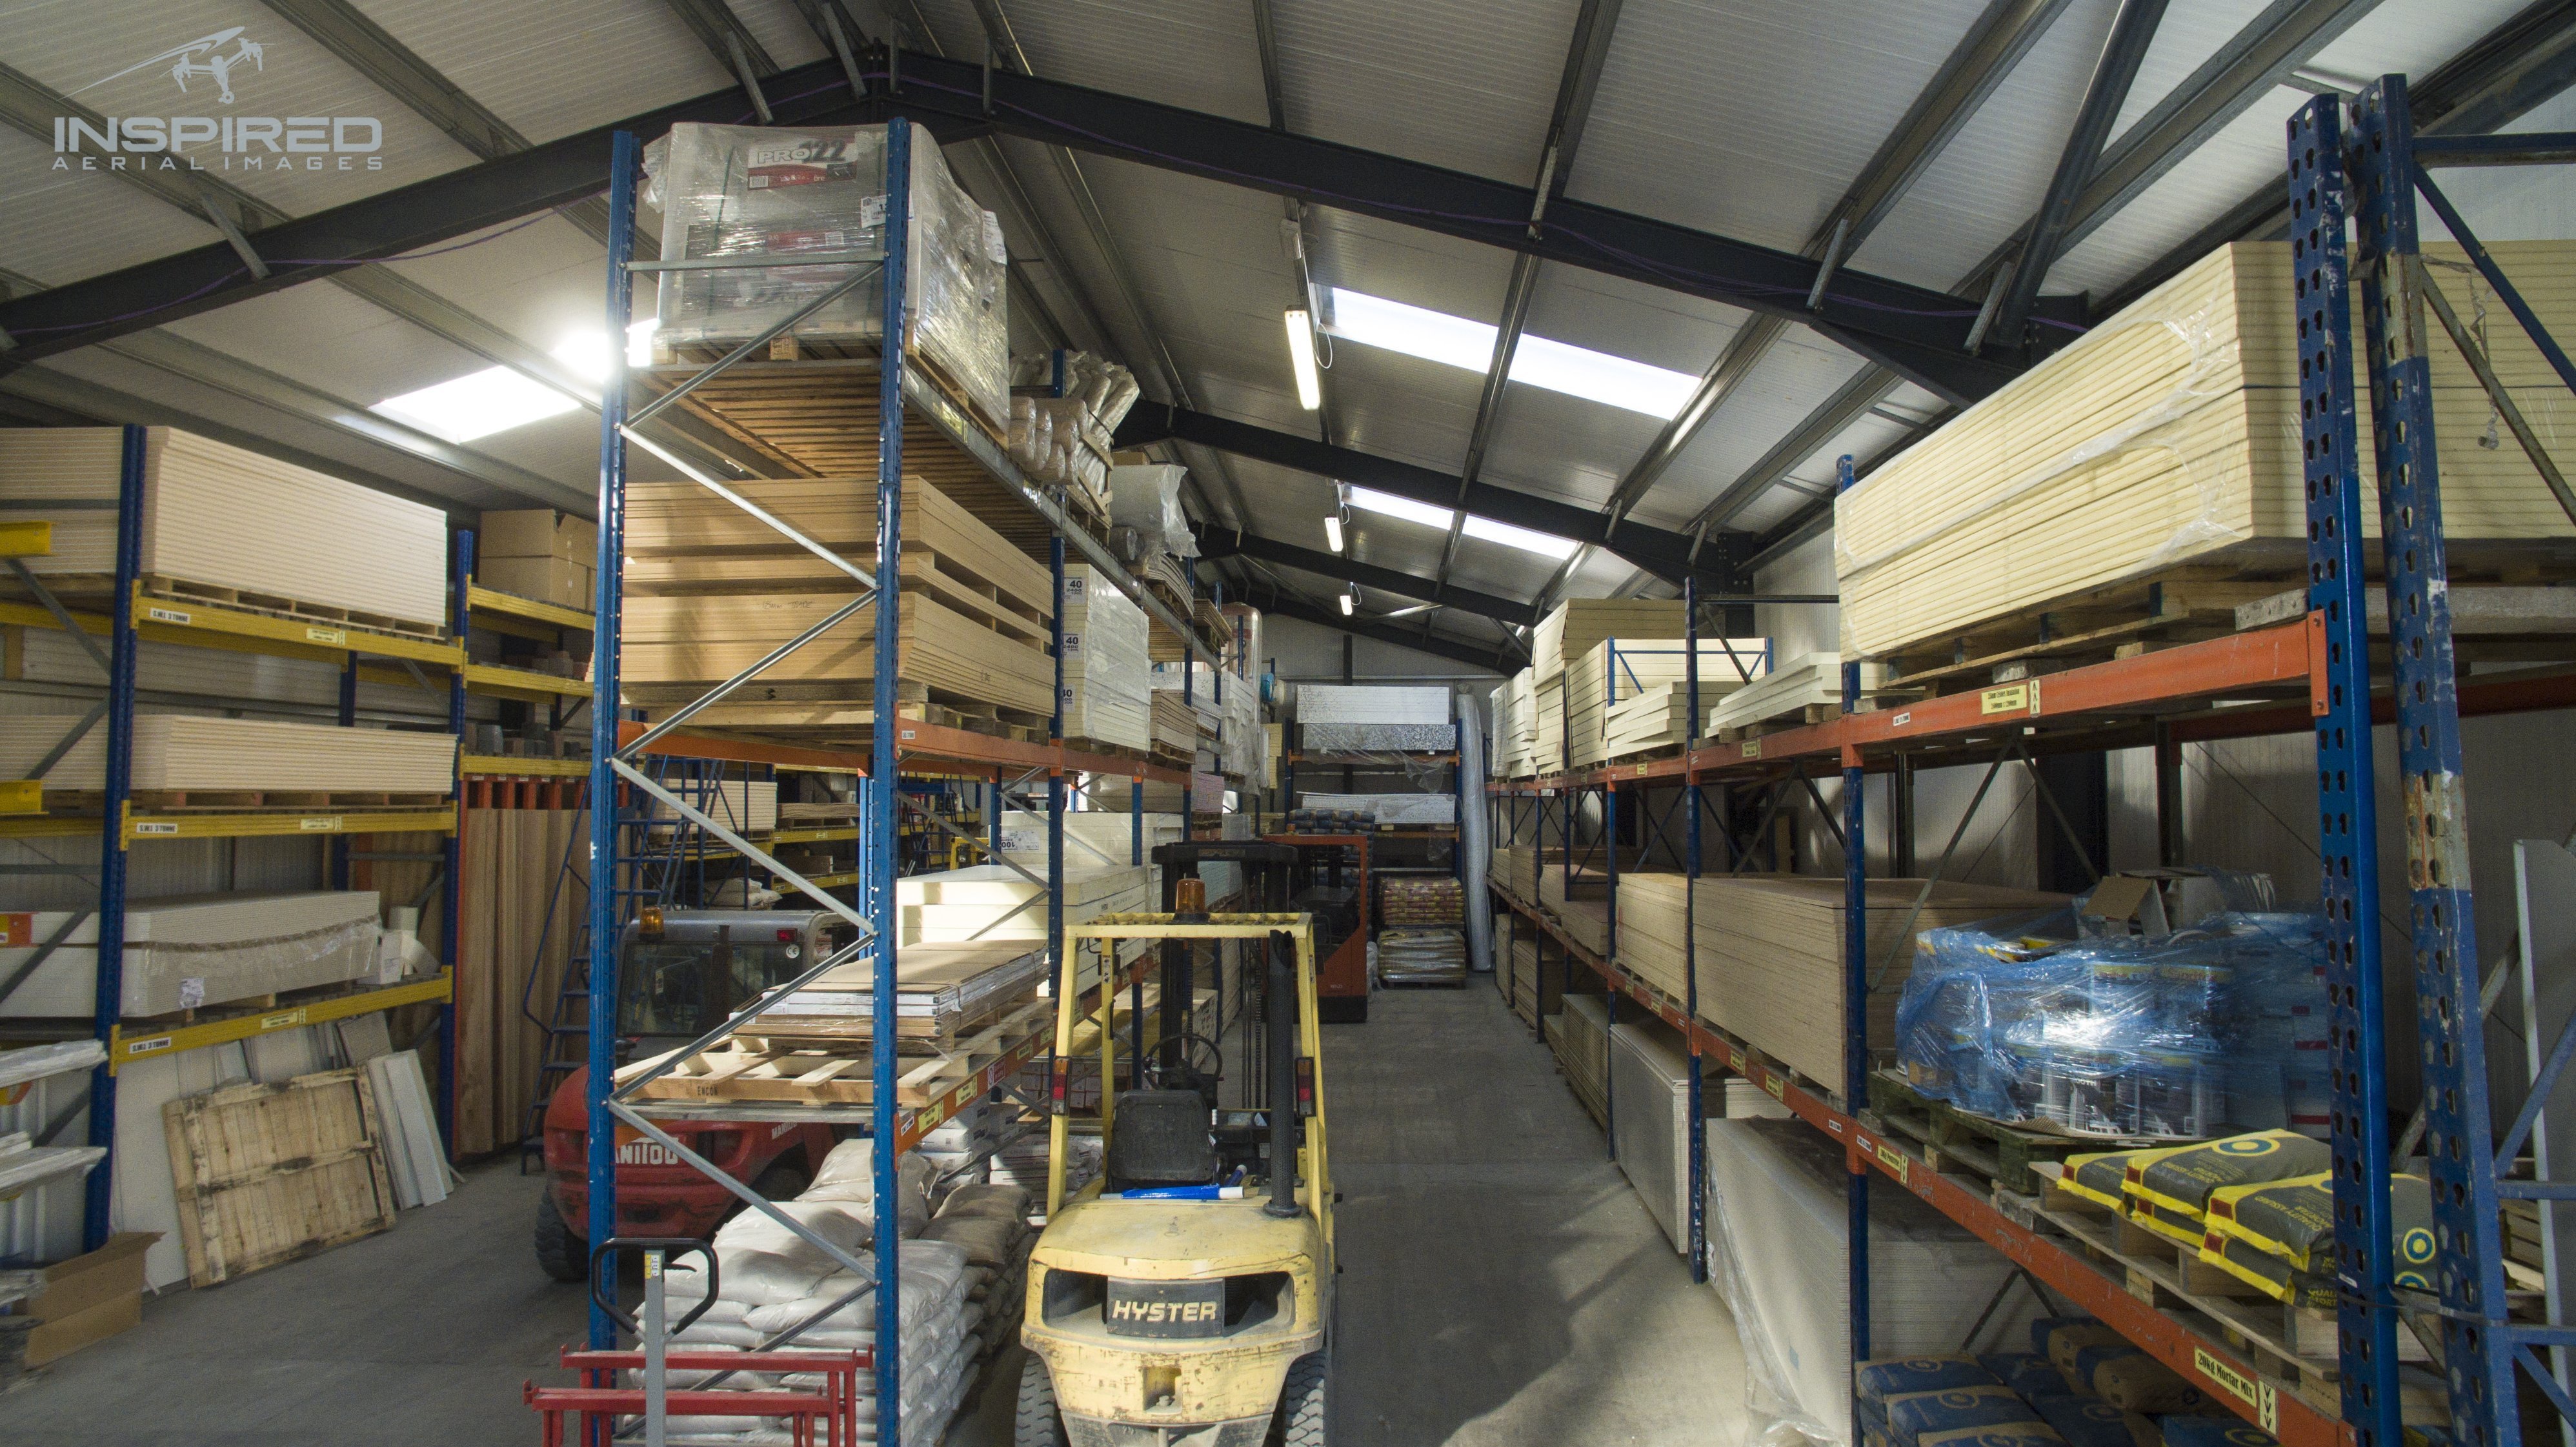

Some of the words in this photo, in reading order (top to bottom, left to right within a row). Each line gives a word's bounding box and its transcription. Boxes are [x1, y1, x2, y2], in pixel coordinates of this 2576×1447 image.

[1065, 636, 1079, 645] 40
[1111, 1300, 1218, 1322] HYSTER
[2216, 1362, 2239, 1390] Mortar
